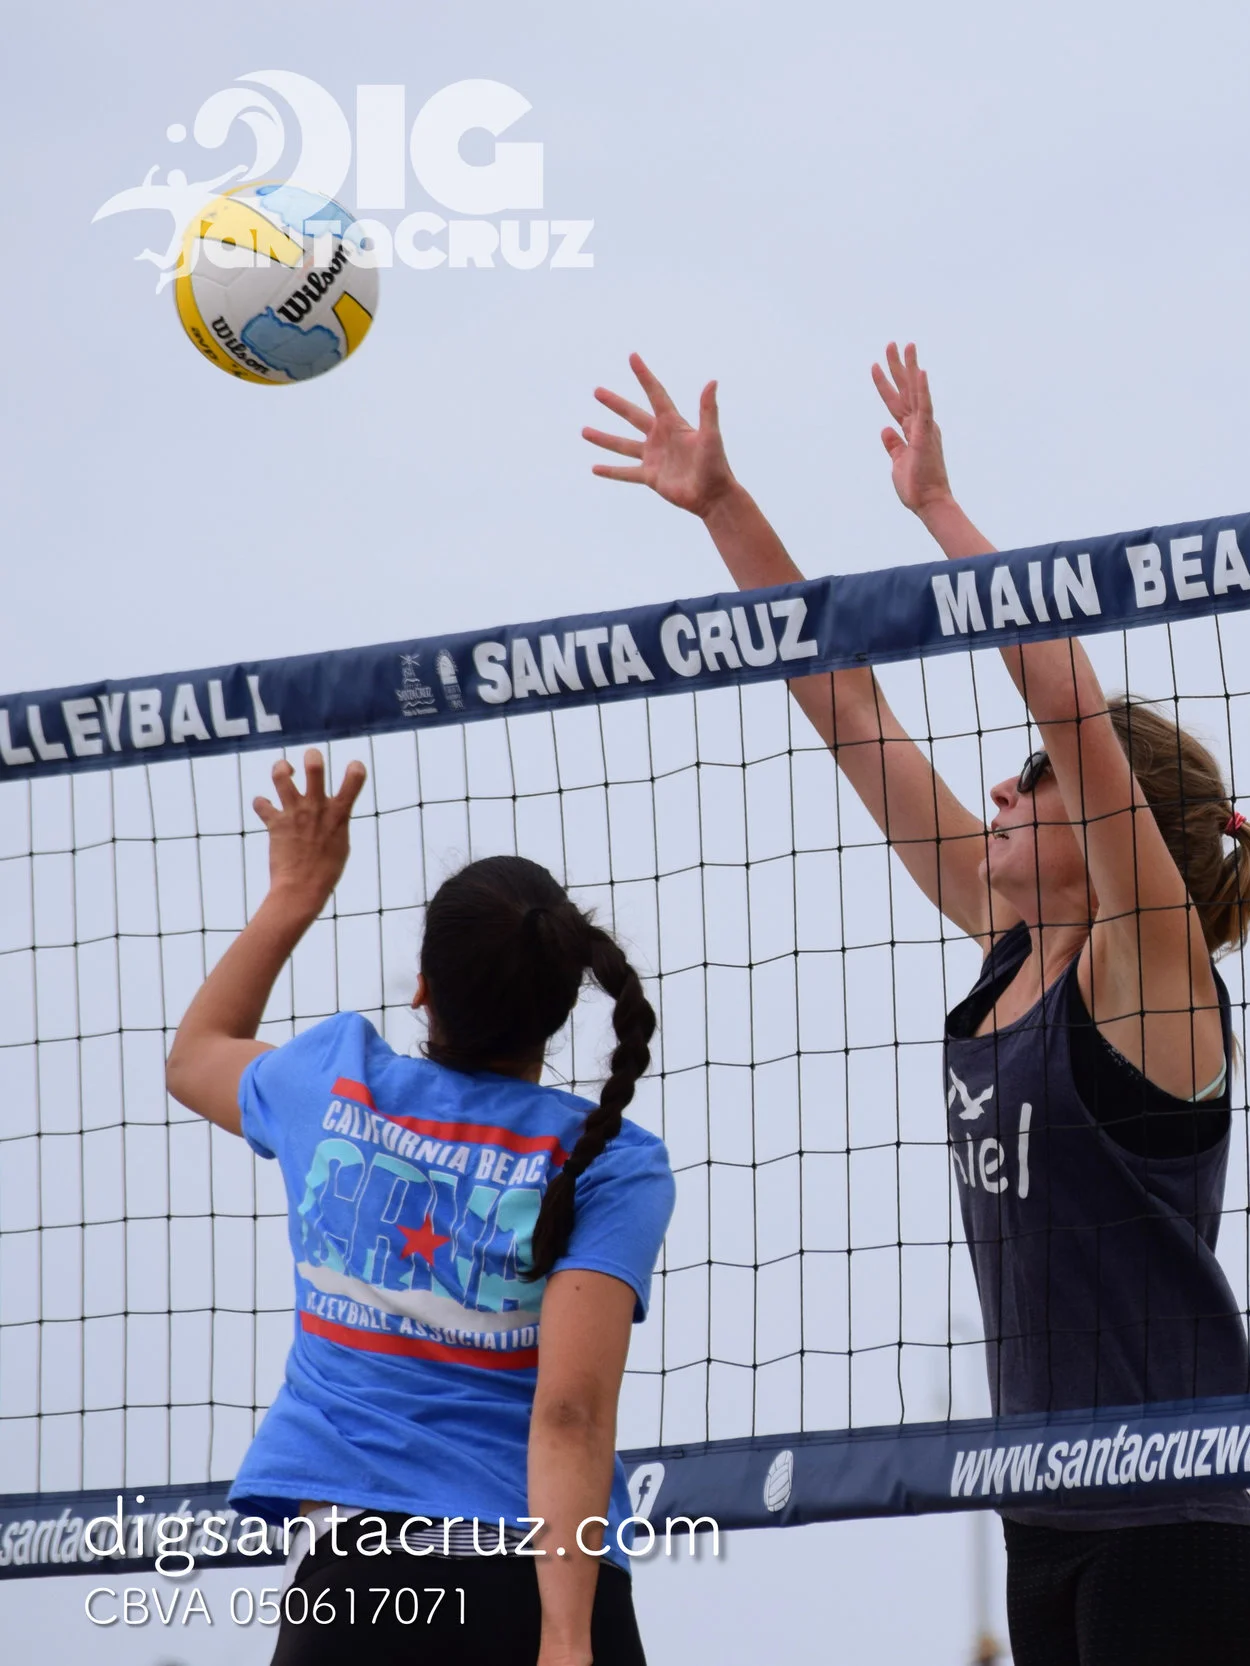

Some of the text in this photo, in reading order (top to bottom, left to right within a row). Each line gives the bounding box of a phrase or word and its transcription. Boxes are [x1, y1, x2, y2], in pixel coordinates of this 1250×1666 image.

[212, 316, 269, 375] Wilson
[932, 553, 1102, 636] MAIN
[472, 624, 655, 704] SANTA
[660, 597, 818, 678] CRUZ
[322, 1100, 548, 1186] CALIFORNIA BEAC
[400, 1316, 540, 1350] ASSOCIATIO
